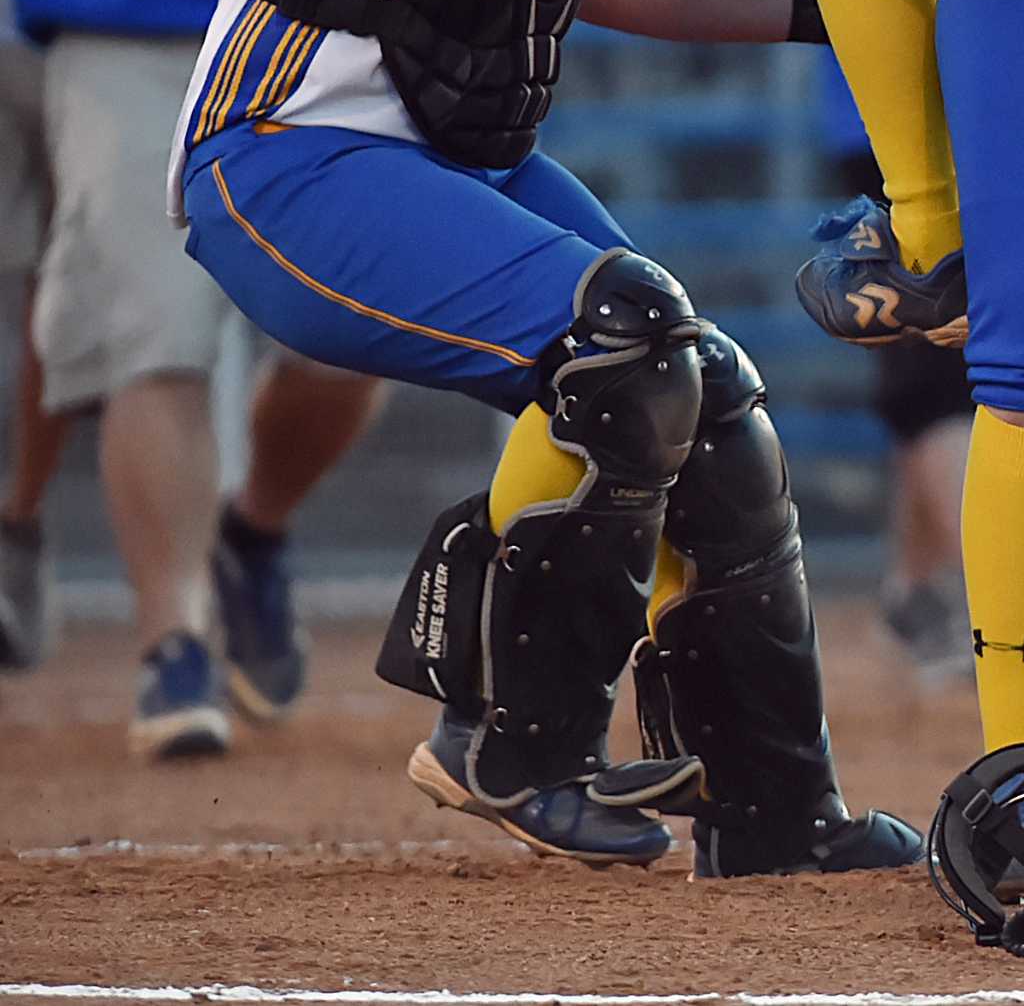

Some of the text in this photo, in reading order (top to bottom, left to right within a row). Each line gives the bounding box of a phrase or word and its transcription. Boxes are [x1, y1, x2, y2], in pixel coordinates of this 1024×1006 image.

[415, 570, 431, 634] EASTON
[425, 562, 449, 659] KNEE SAVER
